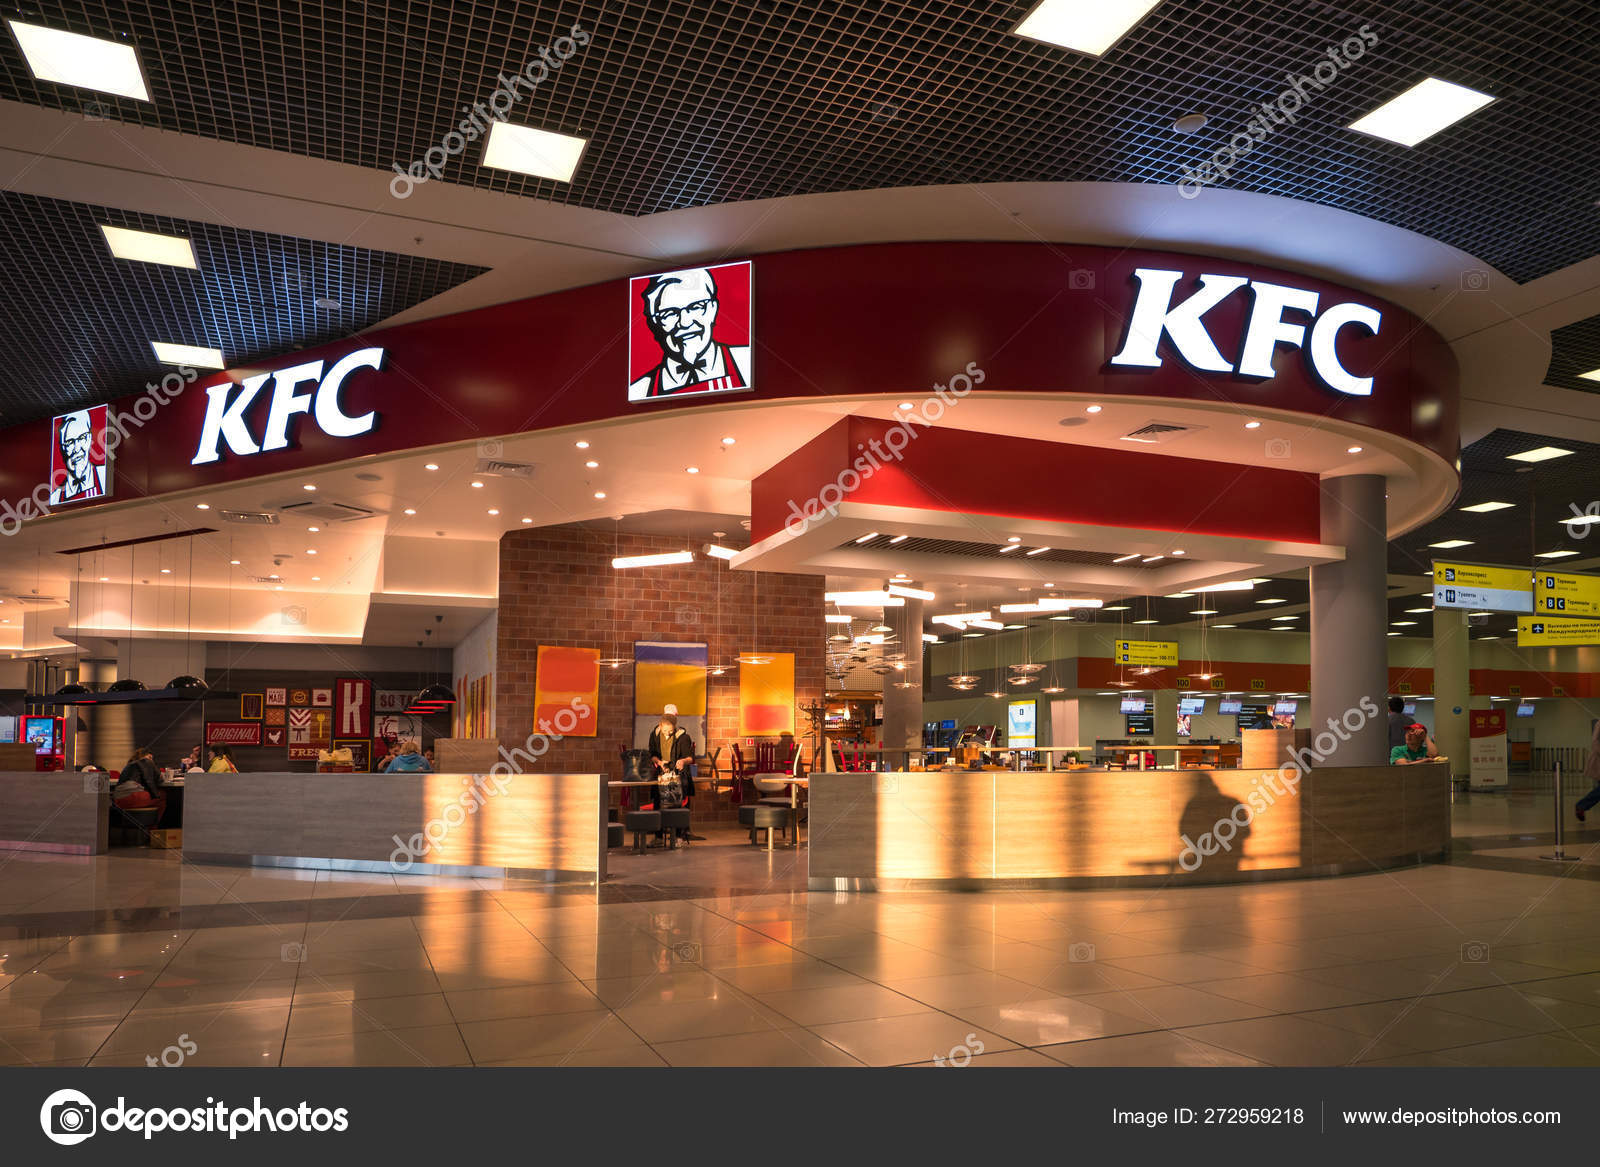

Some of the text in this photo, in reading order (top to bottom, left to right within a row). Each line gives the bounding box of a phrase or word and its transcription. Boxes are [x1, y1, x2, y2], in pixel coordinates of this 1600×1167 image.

[1110, 267, 1382, 396] KFC
[190, 347, 384, 465] KFC
[1176, 679, 1189, 688] 100
[1212, 679, 1223, 689] 101
[1252, 680, 1264, 689] 102
[268, 693, 284, 704] MADE
[380, 694, 396, 708] SO
[342, 682, 363, 734] K
[210, 727, 258, 741] ORIGINAL
[290, 748, 320, 757] FRES
